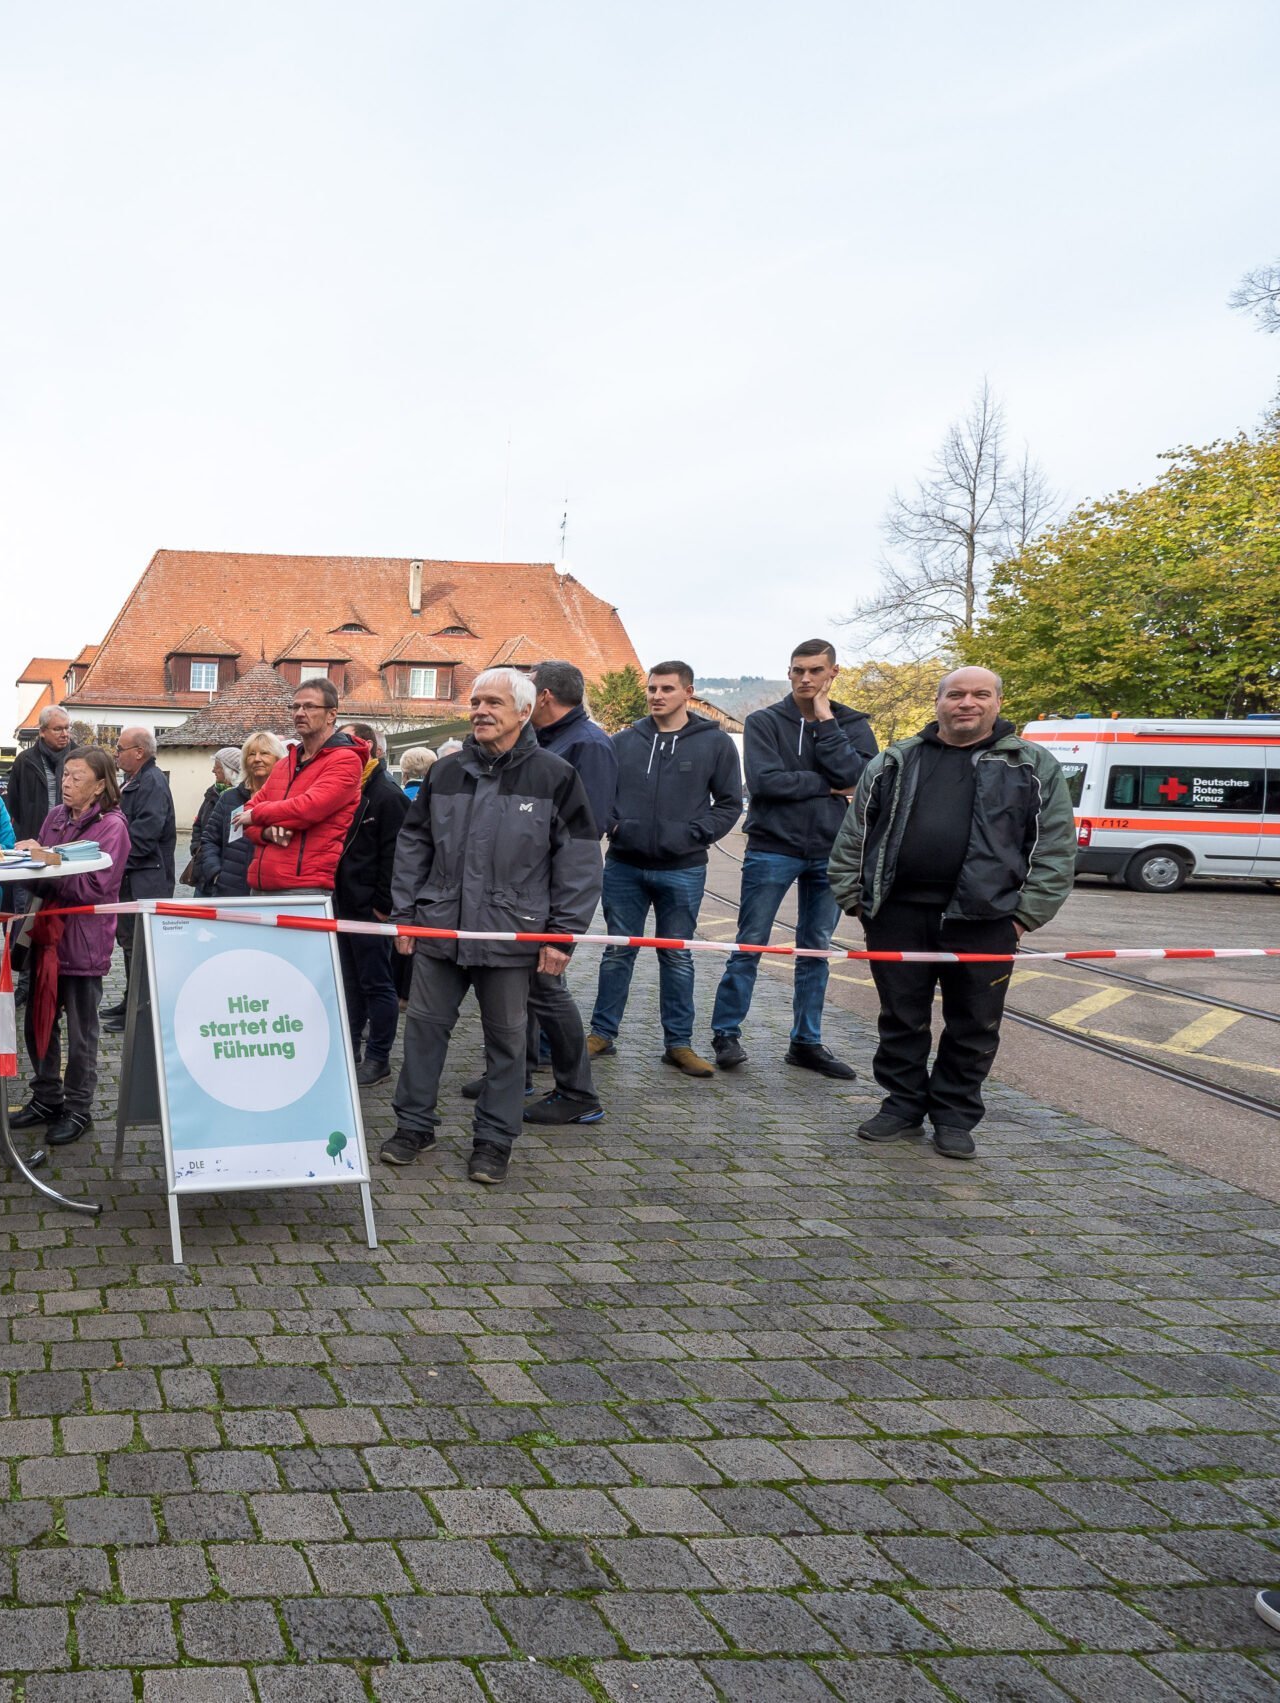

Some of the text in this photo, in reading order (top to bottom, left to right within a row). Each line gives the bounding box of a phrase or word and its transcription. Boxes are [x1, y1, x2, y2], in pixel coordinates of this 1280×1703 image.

[1193, 777, 1250, 787] Deutsches
[1192, 786, 1224, 795] Rotes
[1192, 794, 1224, 803] Kreuz
[1109, 819, 1129, 828] 112
[227, 994, 270, 1014] Hier
[199, 1014, 304, 1038] startet die
[213, 1040, 296, 1060] Führung
[189, 1160, 205, 1170] DLE
